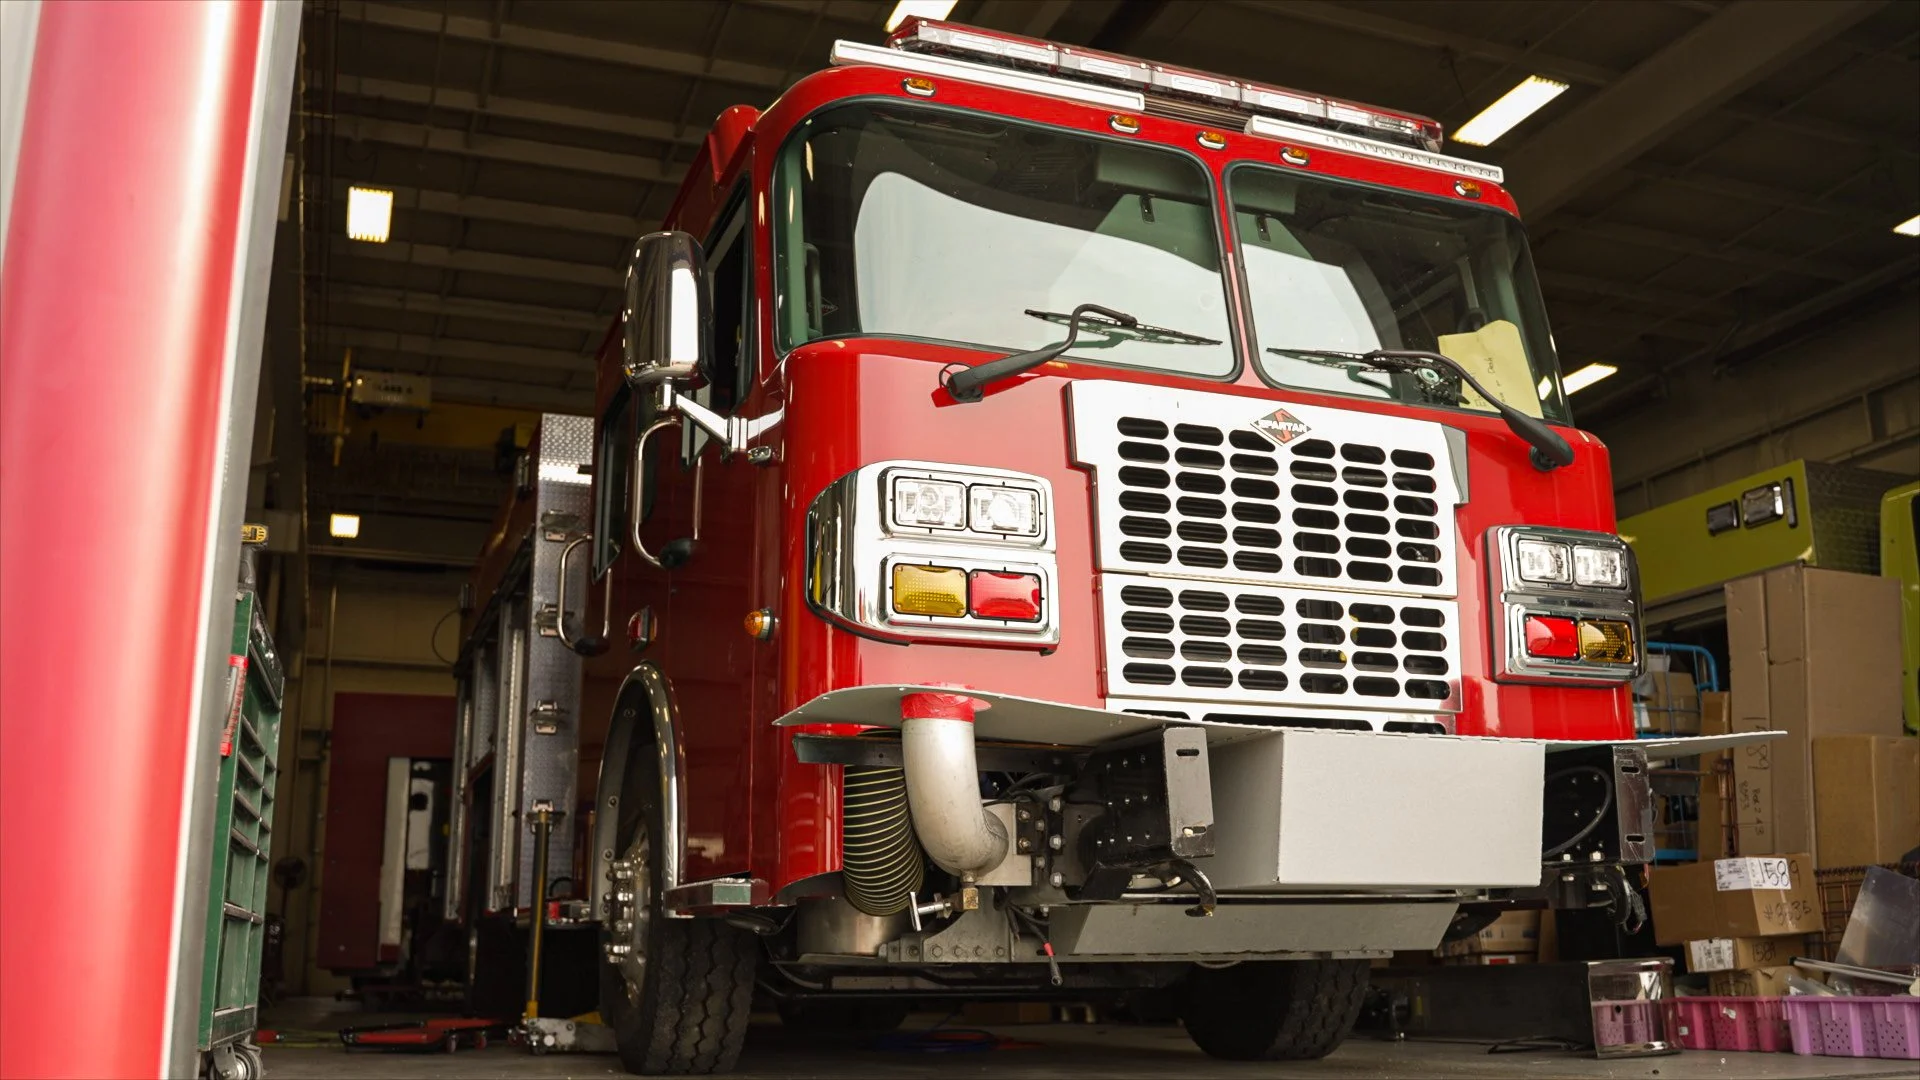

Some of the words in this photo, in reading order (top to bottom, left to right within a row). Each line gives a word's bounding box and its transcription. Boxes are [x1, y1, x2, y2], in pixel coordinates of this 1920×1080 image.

[1259, 419, 1307, 433] SPARTAN
[1742, 717, 1769, 770] 189
[1758, 858, 1802, 888] 1589
